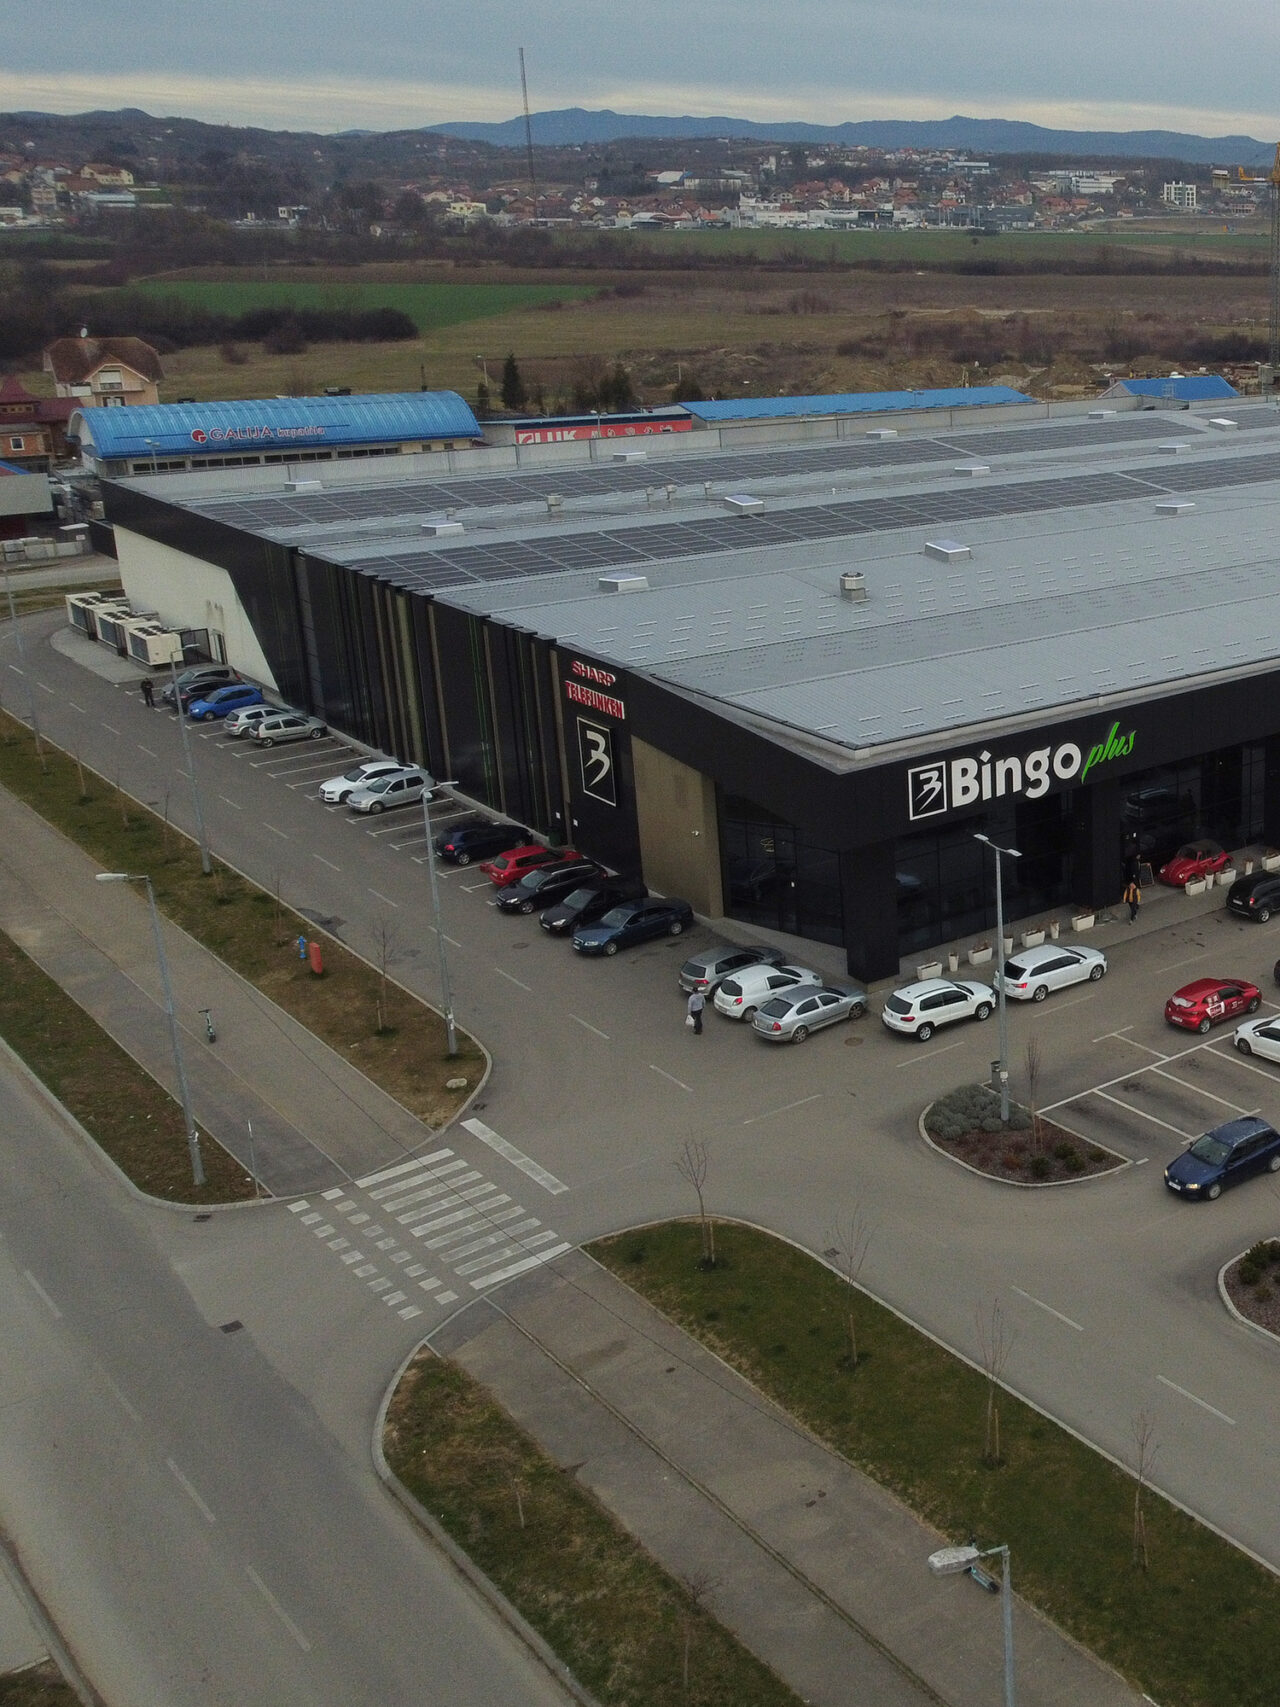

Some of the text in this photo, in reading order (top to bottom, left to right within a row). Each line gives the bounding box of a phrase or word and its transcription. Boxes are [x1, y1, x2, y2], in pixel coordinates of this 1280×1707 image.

[209, 425, 274, 440] GALIJA
[571, 660, 616, 687] SHARP
[565, 680, 625, 720] TELEFUNKEN
[951, 721, 1137, 808] Bingo plus
